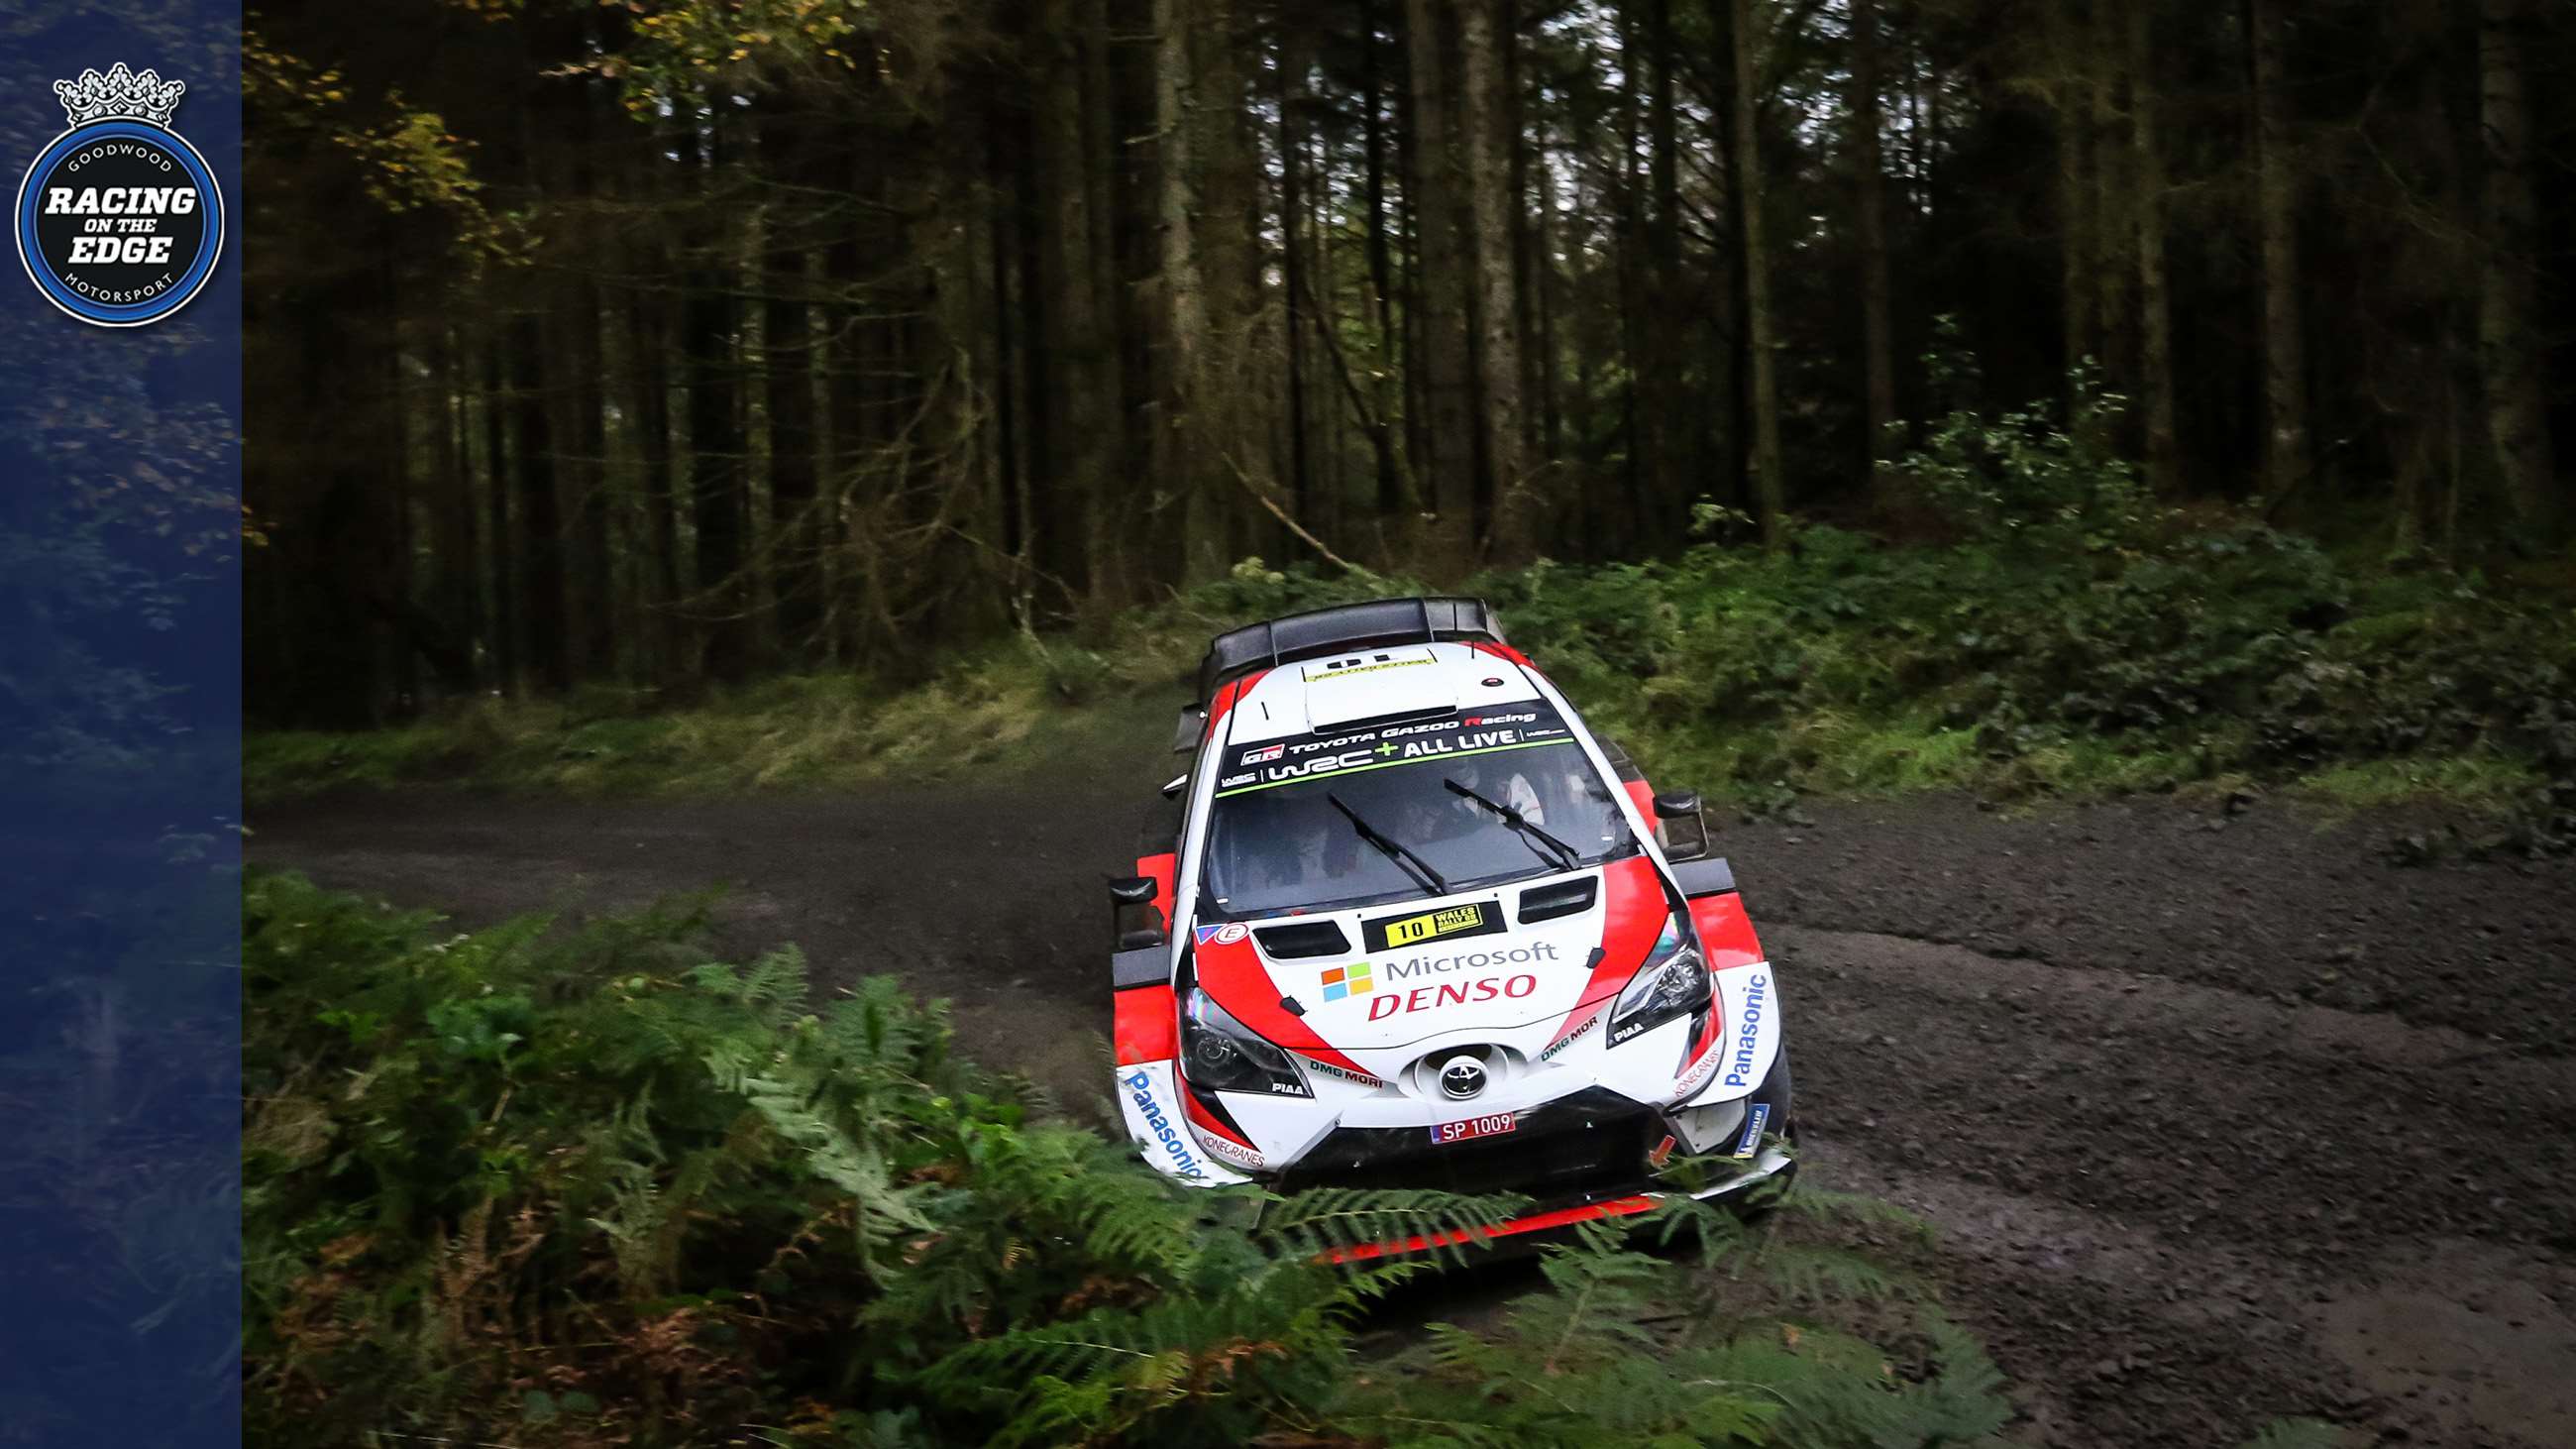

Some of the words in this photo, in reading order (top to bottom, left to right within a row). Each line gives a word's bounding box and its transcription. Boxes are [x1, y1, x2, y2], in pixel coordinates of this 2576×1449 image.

[1242, 747, 1282, 764] GR
[1289, 732, 1376, 754] TOYOTA
[1381, 721, 1460, 738] GAZOO
[1464, 713, 1537, 727] Racing
[1404, 738, 1453, 757] ALL
[1458, 729, 1517, 749] LIVE
[1436, 907, 1475, 922] WALES
[1224, 927, 1240, 939] E
[1398, 922, 1424, 939] 10
[1386, 941, 1559, 981] Microsoft
[1368, 974, 1537, 1022] DENSO
[1614, 1023, 1645, 1043] PIAA
[1724, 974, 1767, 1087] Panasonic
[1541, 1037, 1569, 1062] DMG
[1310, 1059, 1342, 1077] DMG
[1344, 1070, 1384, 1088] MORI
[1271, 1082, 1304, 1095] PIAA
[1443, 1122, 1466, 1140] SP
[1471, 1115, 1510, 1135] 1009
[1203, 1135, 1265, 1168] KONECRANES
